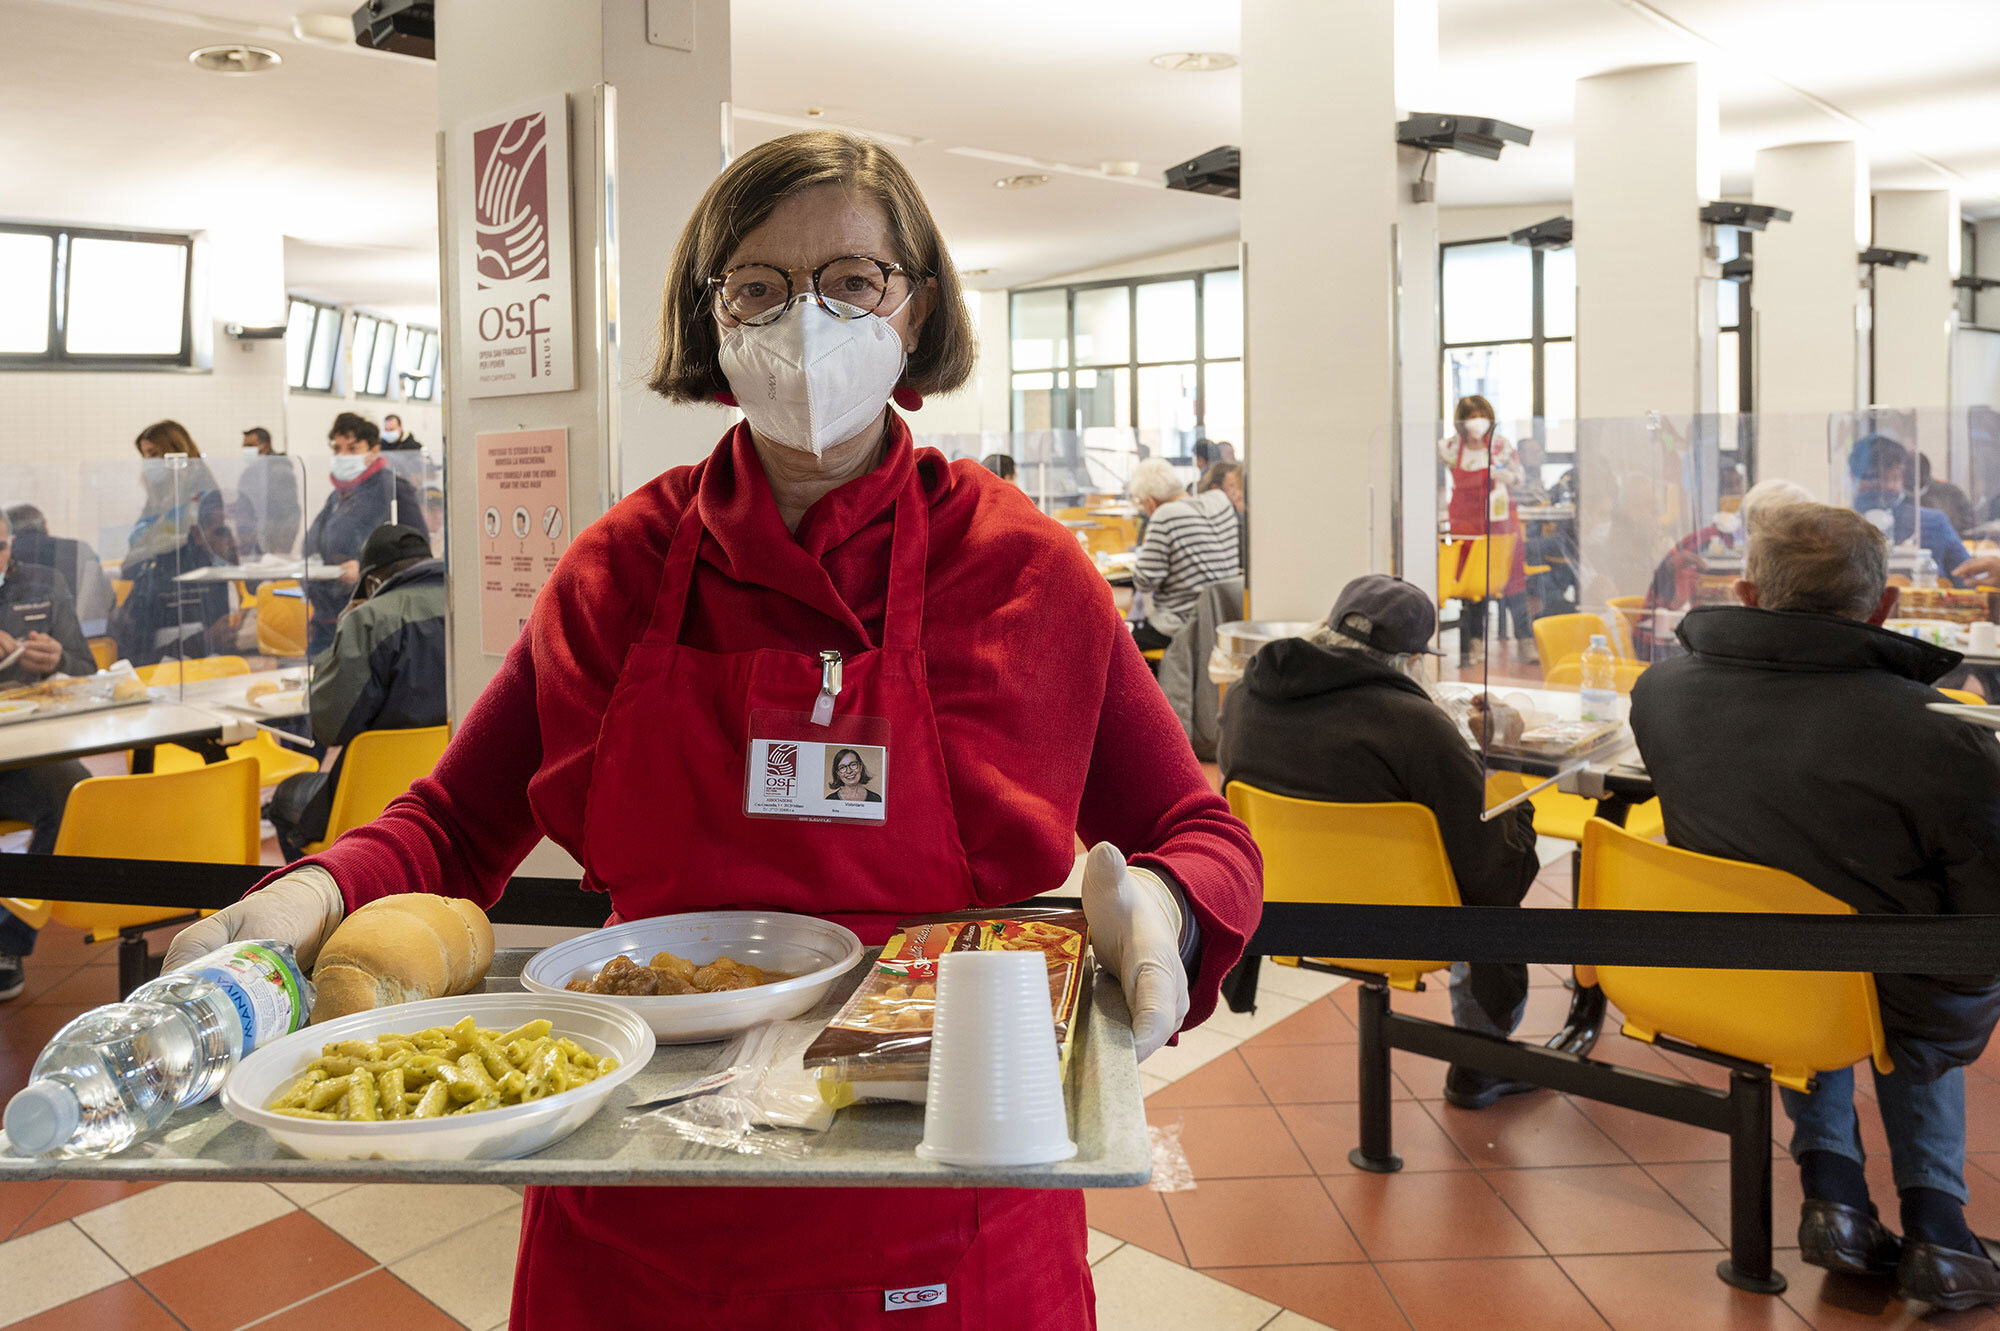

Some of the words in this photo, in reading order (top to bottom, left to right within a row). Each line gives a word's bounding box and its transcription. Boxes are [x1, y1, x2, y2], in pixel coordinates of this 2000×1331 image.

[479, 293, 550, 378] osf
[520, 541, 524, 553] 2
[766, 777, 796, 796] osf
[217, 975, 253, 1038] MANIVA
